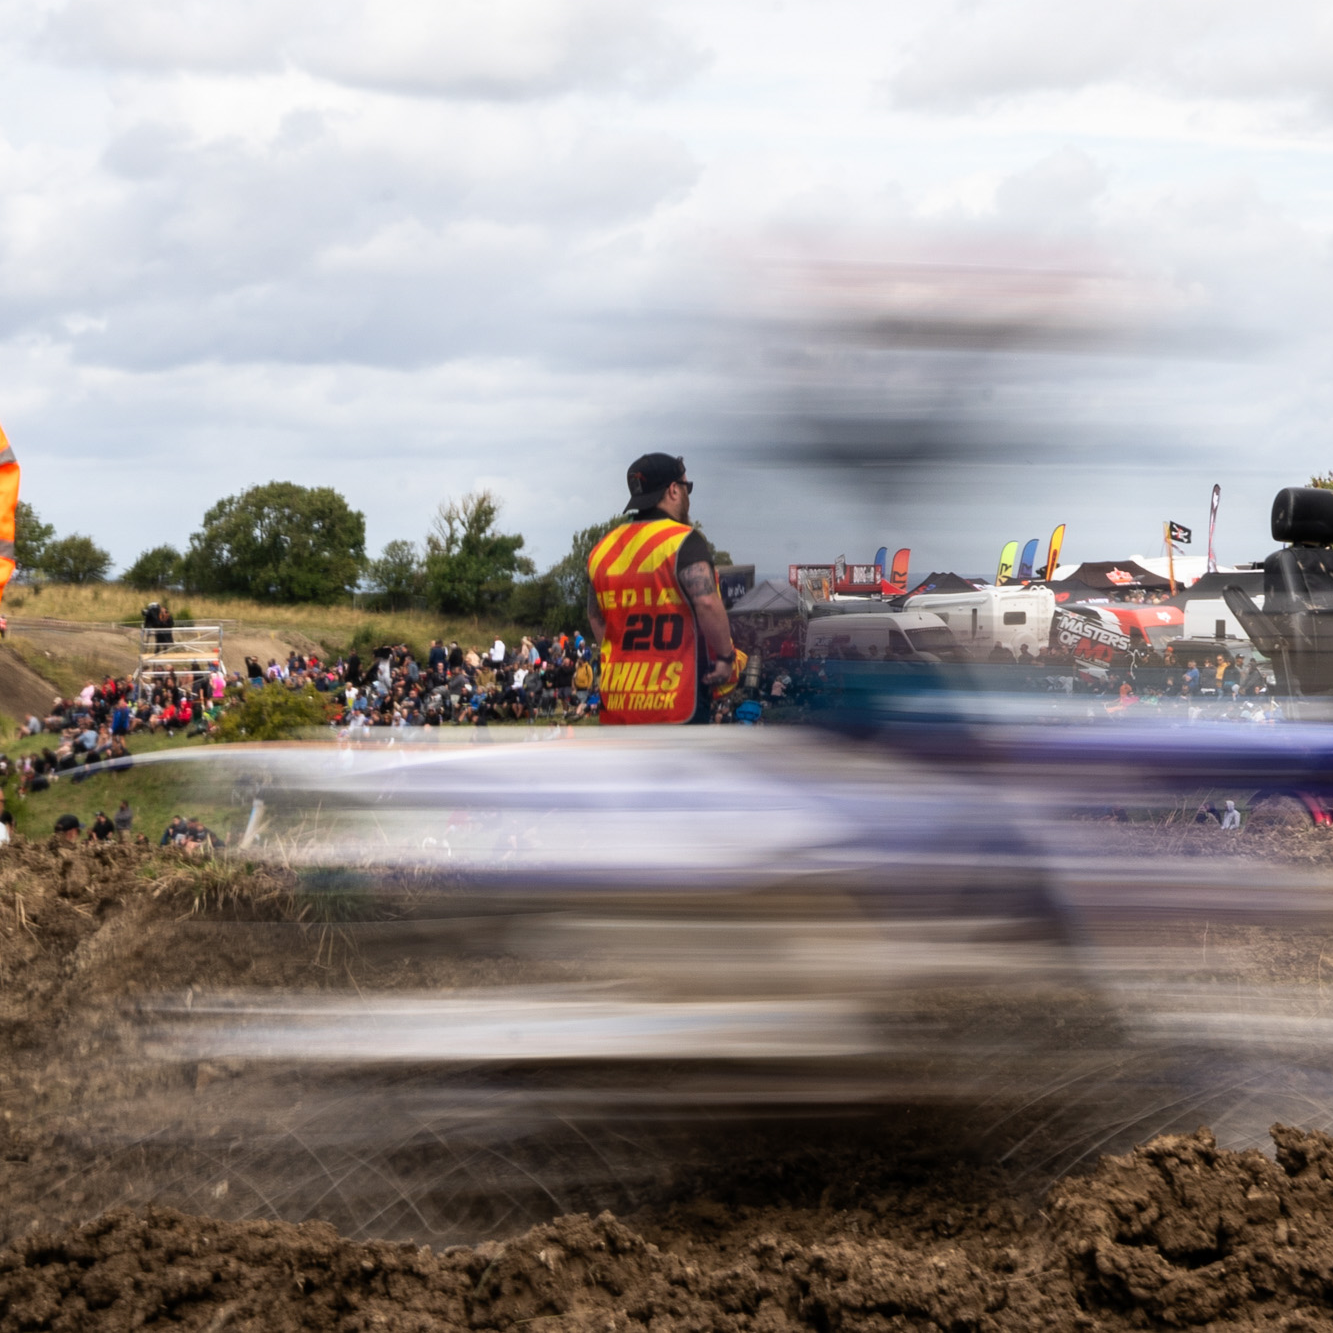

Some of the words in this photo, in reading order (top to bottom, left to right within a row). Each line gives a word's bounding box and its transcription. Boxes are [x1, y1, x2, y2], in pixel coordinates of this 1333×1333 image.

[622, 613, 684, 652] 20
[1060, 616, 1131, 651] MASTERS
[1060, 631, 1082, 646] OF
[607, 692, 626, 711] MX
[628, 691, 678, 711] TRACK
